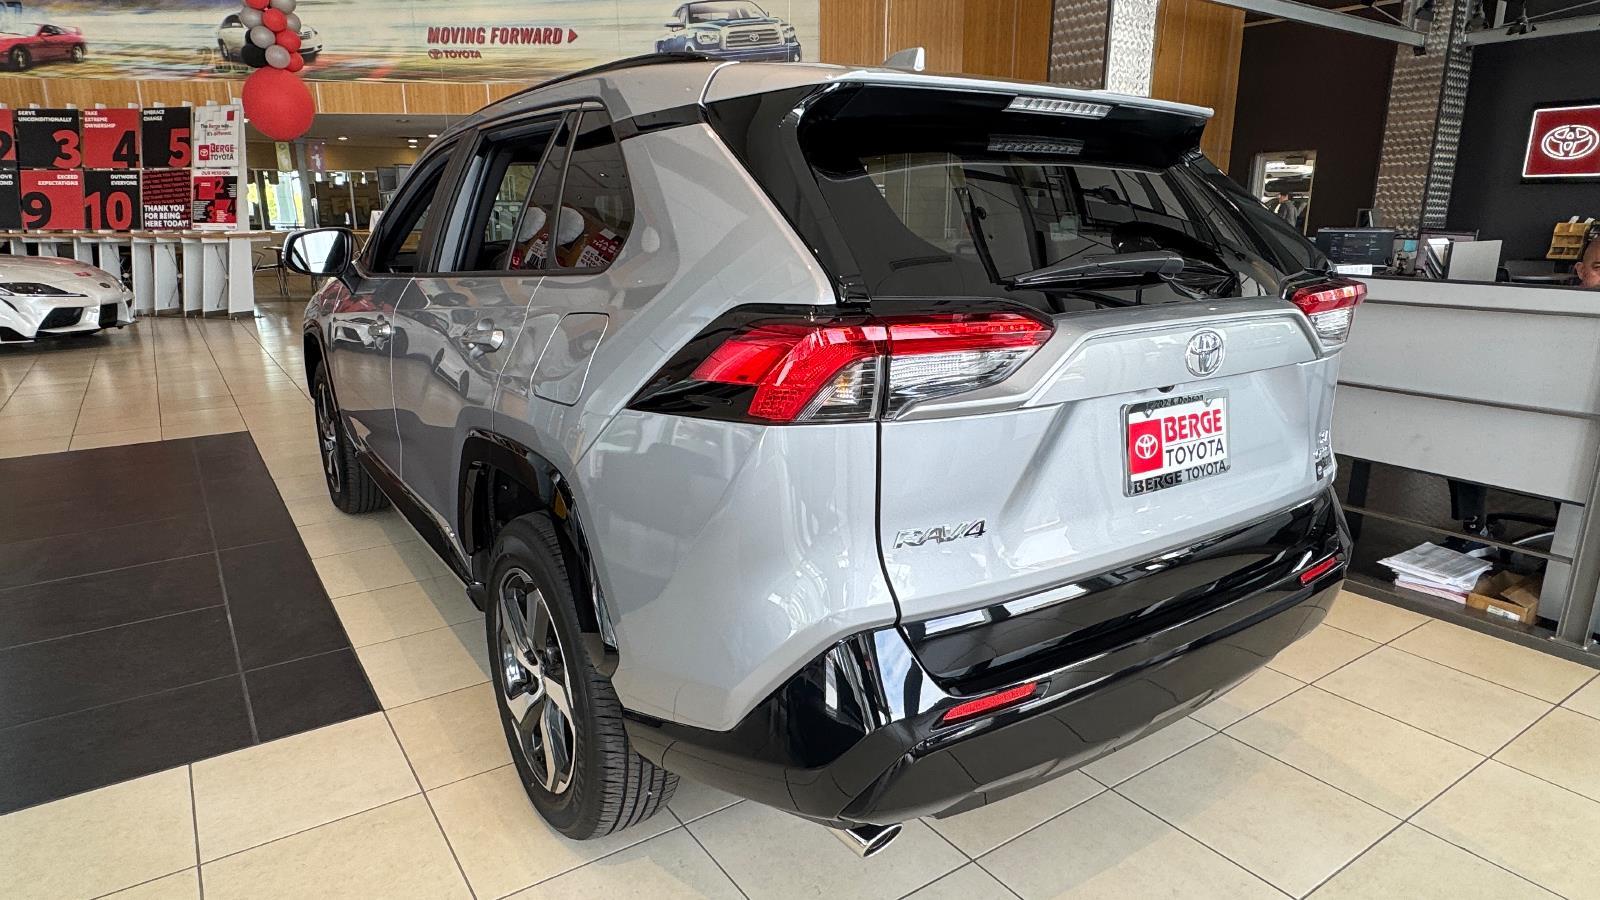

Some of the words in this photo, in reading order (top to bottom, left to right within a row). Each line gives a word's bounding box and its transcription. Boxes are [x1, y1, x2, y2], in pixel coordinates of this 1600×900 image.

[427, 26, 486, 44] MOVING
[490, 26, 563, 44] FORWARD
[443, 50, 482, 59] TOYOTA
[52, 129, 82, 168] 3
[112, 130, 140, 168] 4
[168, 128, 192, 168] 5
[210, 143, 234, 153] BERGE
[22, 192, 52, 229] 9
[84, 192, 132, 230] 10
[1164, 408, 1222, 443] BERGE
[1166, 438, 1224, 466] TOYOTA
[1133, 470, 1182, 494] BERGE
[1185, 460, 1226, 480] TOYOTA
[892, 520, 986, 549] RAV4
